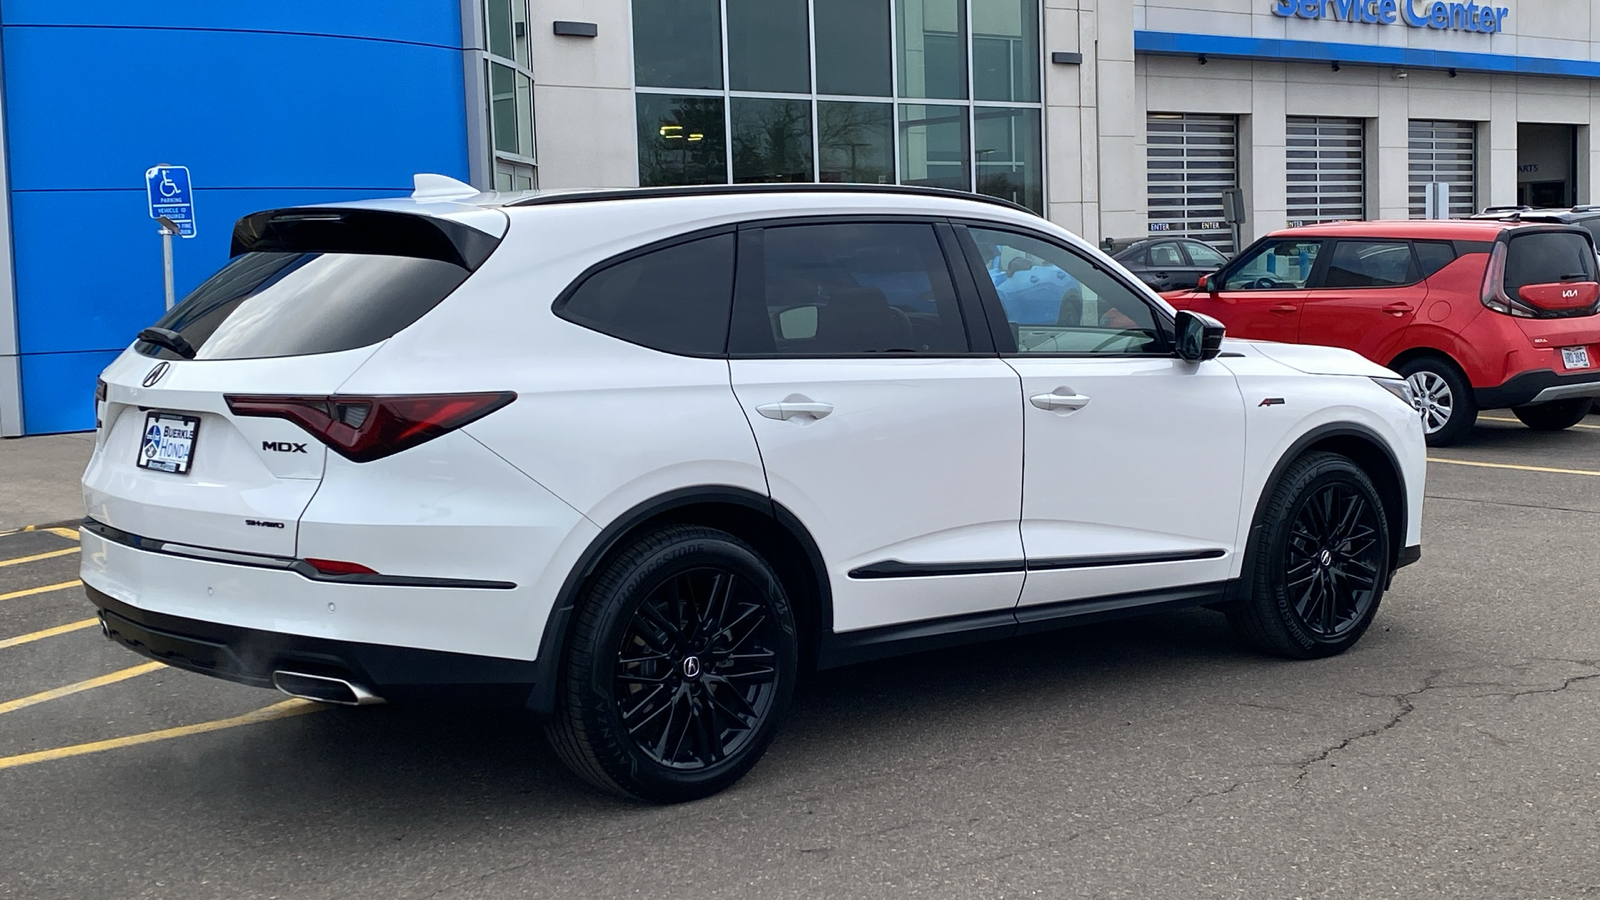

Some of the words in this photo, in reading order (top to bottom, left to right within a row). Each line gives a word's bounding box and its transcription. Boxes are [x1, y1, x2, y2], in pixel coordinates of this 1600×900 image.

[1274, 0, 1397, 25] Service
[1403, 0, 1509, 33] Center
[1150, 223, 1170, 231] ENTER
[1201, 222, 1220, 230] ENTER
[1562, 290, 1578, 298] KIA
[159, 437, 190, 459] HONDA
[262, 441, 308, 454] MDX
